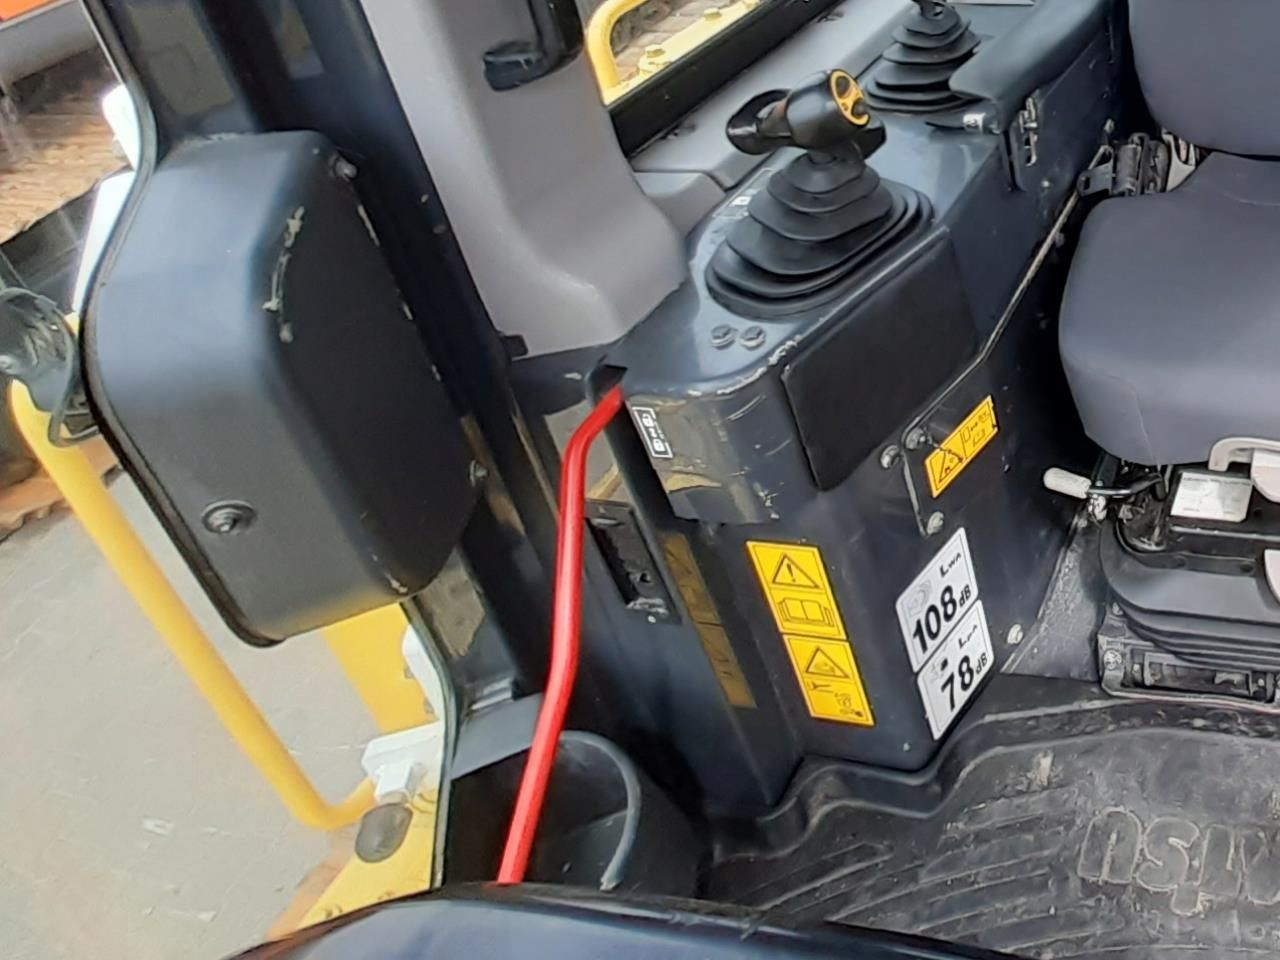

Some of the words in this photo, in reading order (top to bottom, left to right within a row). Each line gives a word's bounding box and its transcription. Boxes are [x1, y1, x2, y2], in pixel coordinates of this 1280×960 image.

[913, 585, 957, 654] 108
[959, 584, 971, 607] dB
[941, 655, 974, 712] 78
[976, 652, 988, 675] dB
